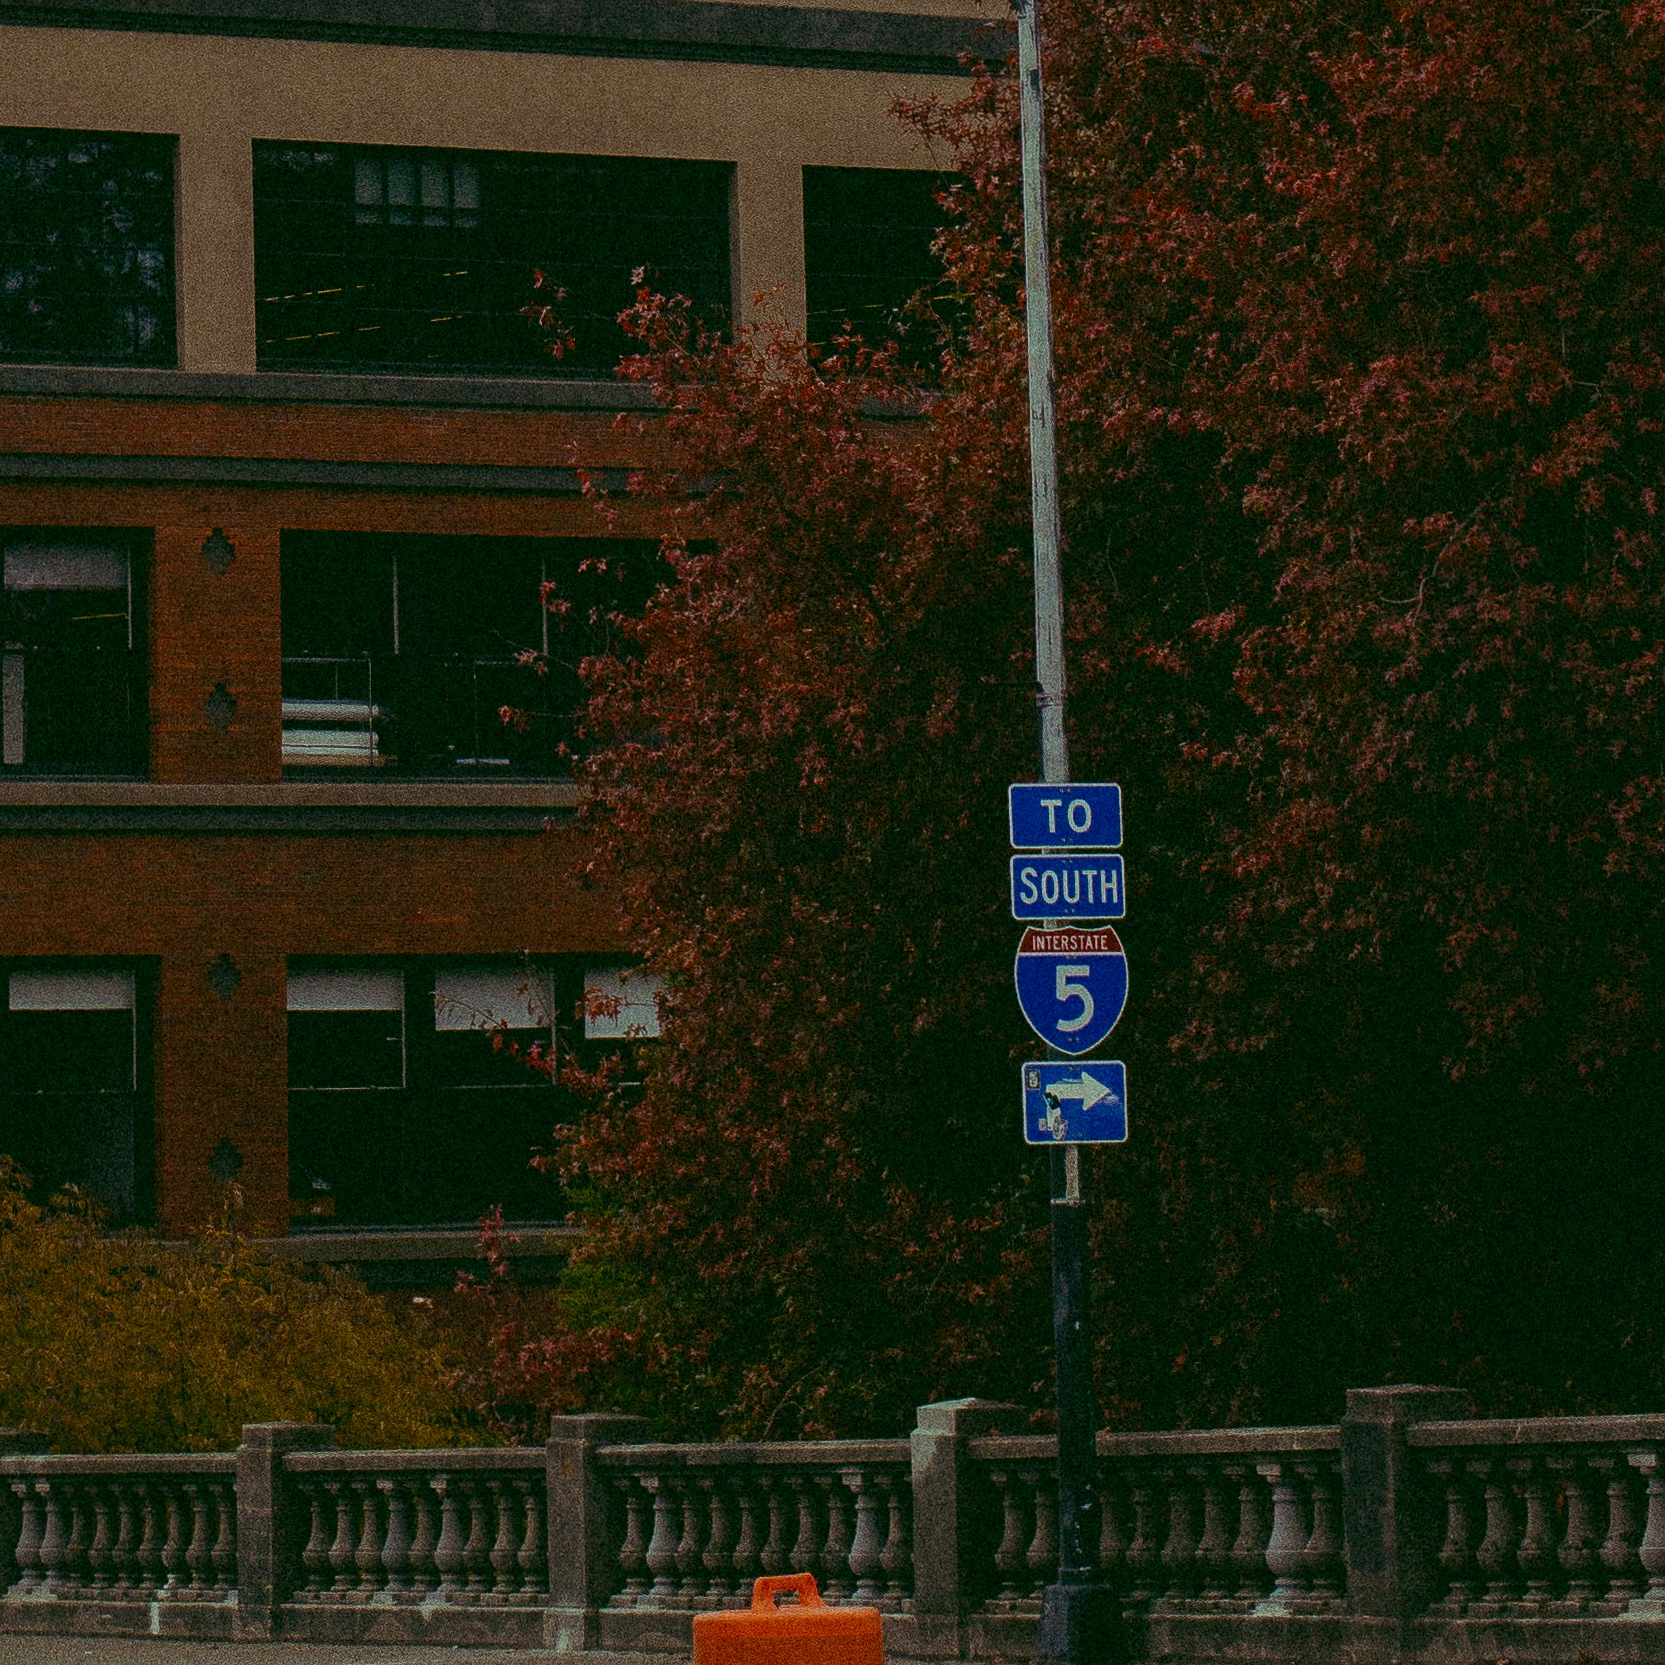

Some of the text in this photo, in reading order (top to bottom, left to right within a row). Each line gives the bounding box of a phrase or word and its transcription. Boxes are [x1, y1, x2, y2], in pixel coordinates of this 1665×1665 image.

[1041, 799, 1092, 833] TO
[1019, 867, 1119, 904] SOUTH
[1032, 934, 1108, 951] INTERSTATE
[1056, 965, 1094, 1032] 5
